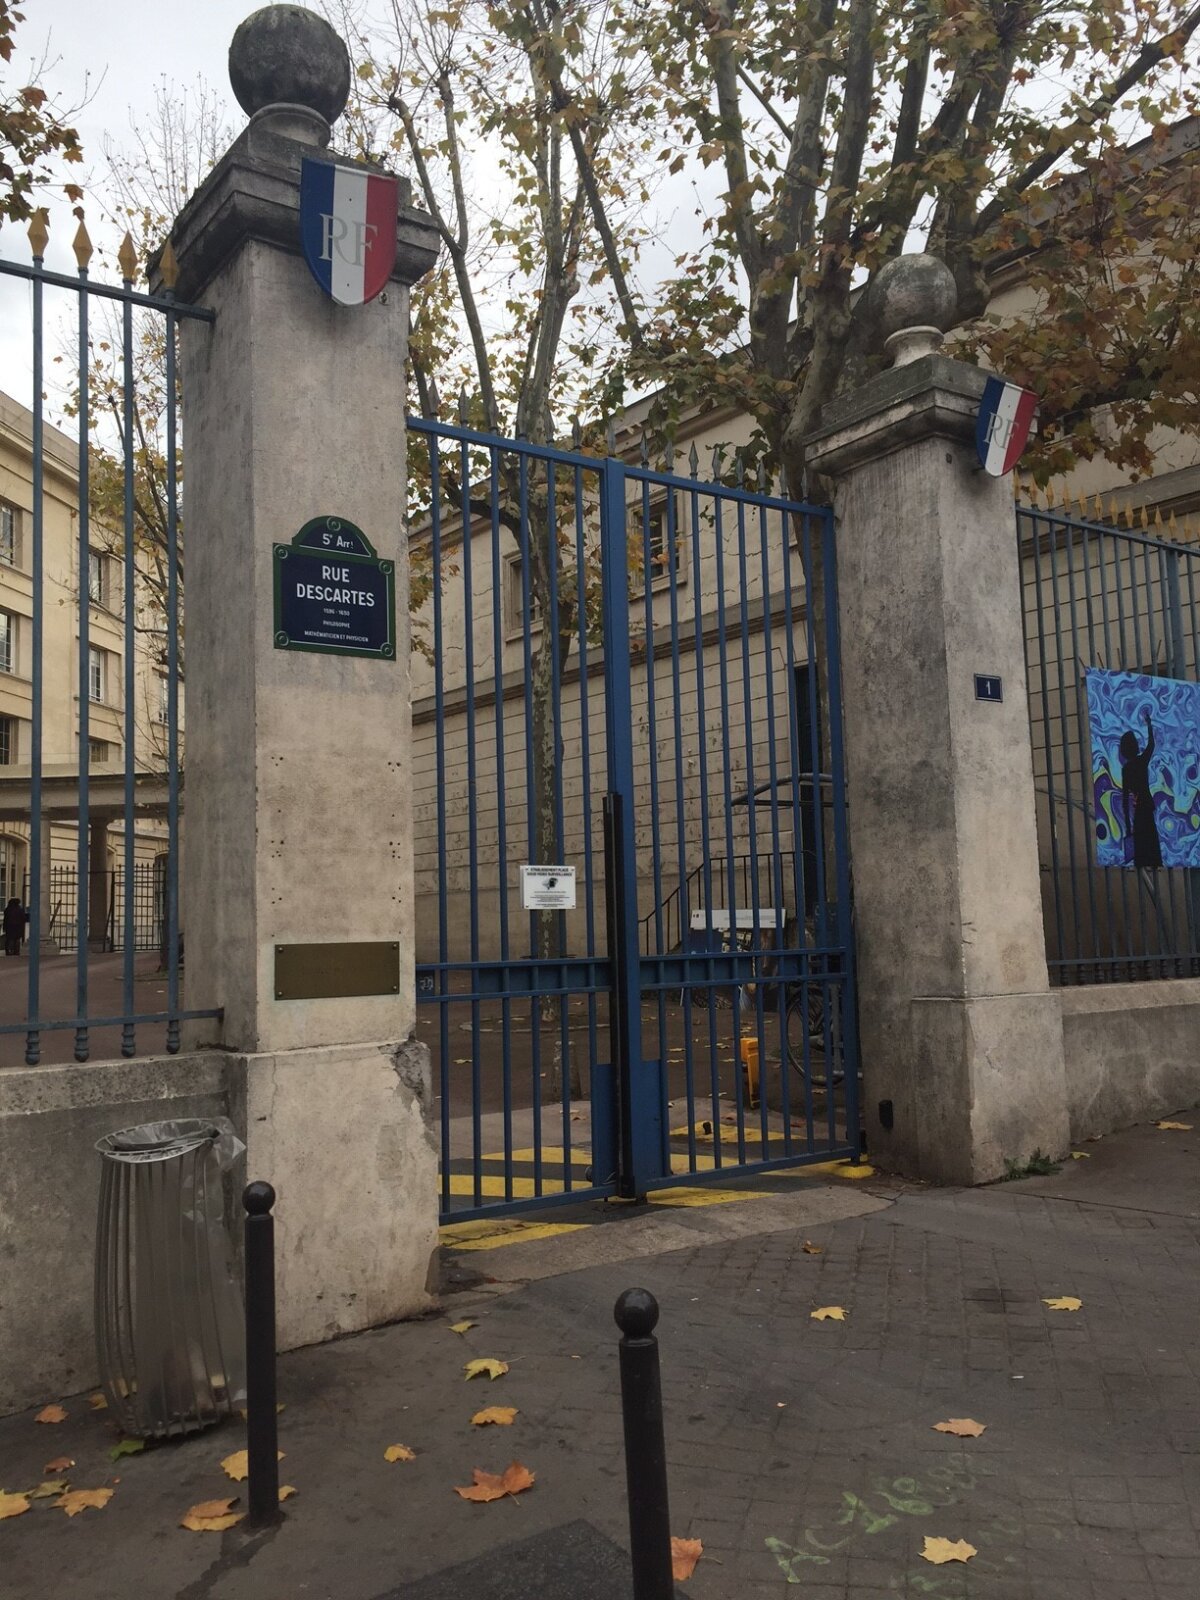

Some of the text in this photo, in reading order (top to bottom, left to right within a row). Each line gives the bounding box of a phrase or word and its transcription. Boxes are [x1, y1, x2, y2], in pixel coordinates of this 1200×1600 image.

[318, 213, 378, 267] RF
[983, 412, 1019, 449] RF
[322, 565, 350, 583] RUE
[296, 583, 375, 607] DESCARTES
[322, 620, 350, 628] PHILOSOPHE
[346, 634, 369, 642] PHYSICIEN
[986, 680, 991, 695] 1
